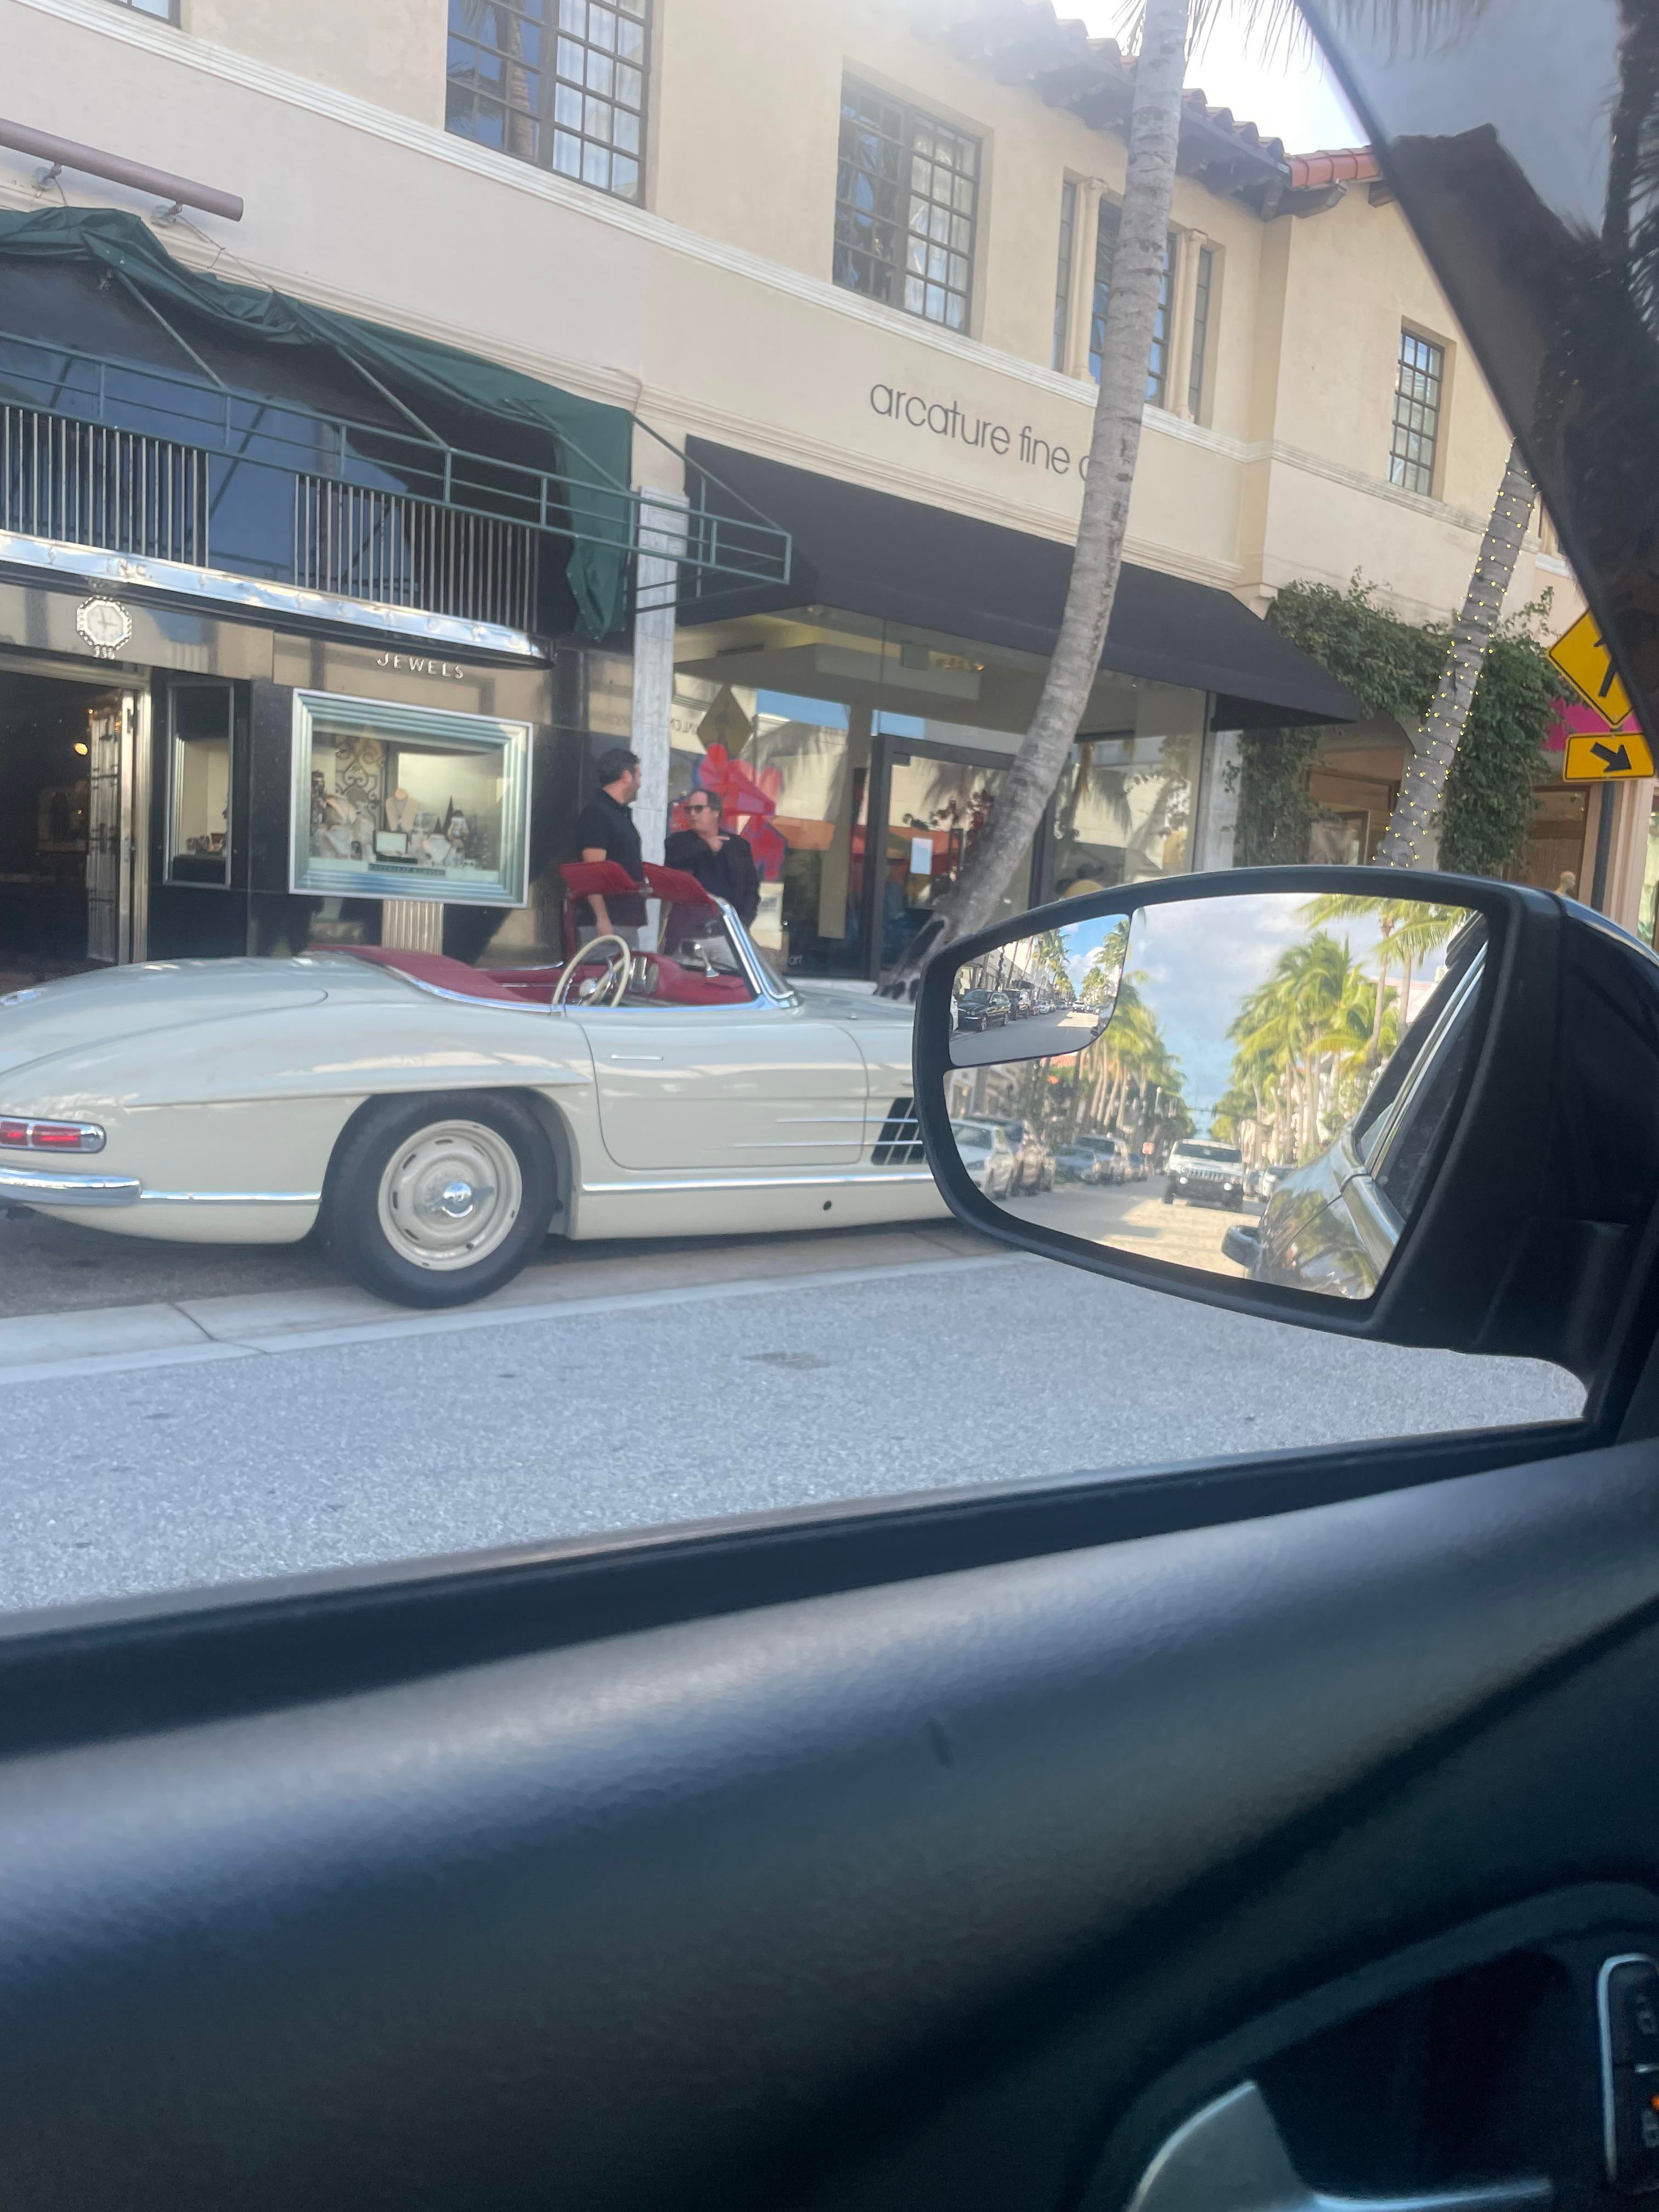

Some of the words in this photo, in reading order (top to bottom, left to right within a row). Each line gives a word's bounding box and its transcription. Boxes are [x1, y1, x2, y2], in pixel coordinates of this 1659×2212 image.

[870, 383, 1010, 454] arcature
[1019, 426, 1071, 475] fine
[377, 652, 464, 679] JEWELS
